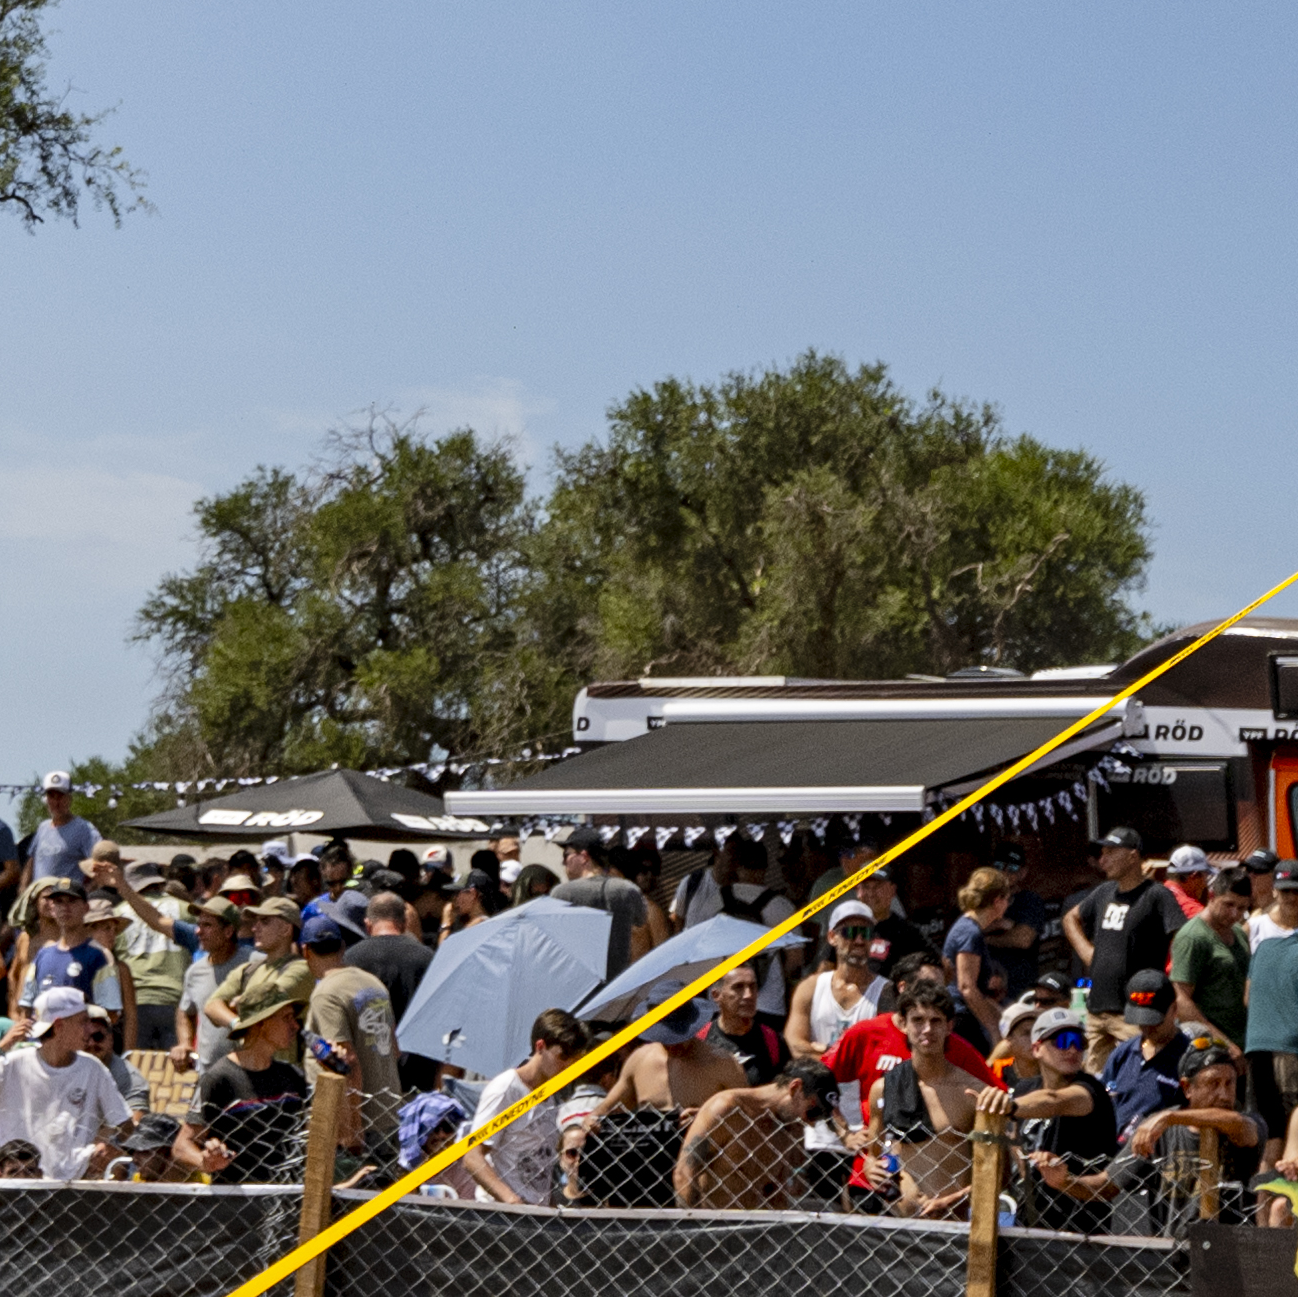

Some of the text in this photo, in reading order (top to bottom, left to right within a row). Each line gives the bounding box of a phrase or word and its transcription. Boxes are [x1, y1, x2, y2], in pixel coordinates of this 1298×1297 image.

[1154, 718, 1204, 742] RÖD
[1242, 730, 1265, 740] YPF
[245, 808, 325, 827] RÖD
[491, 1086, 547, 1132] KINEDYNE
